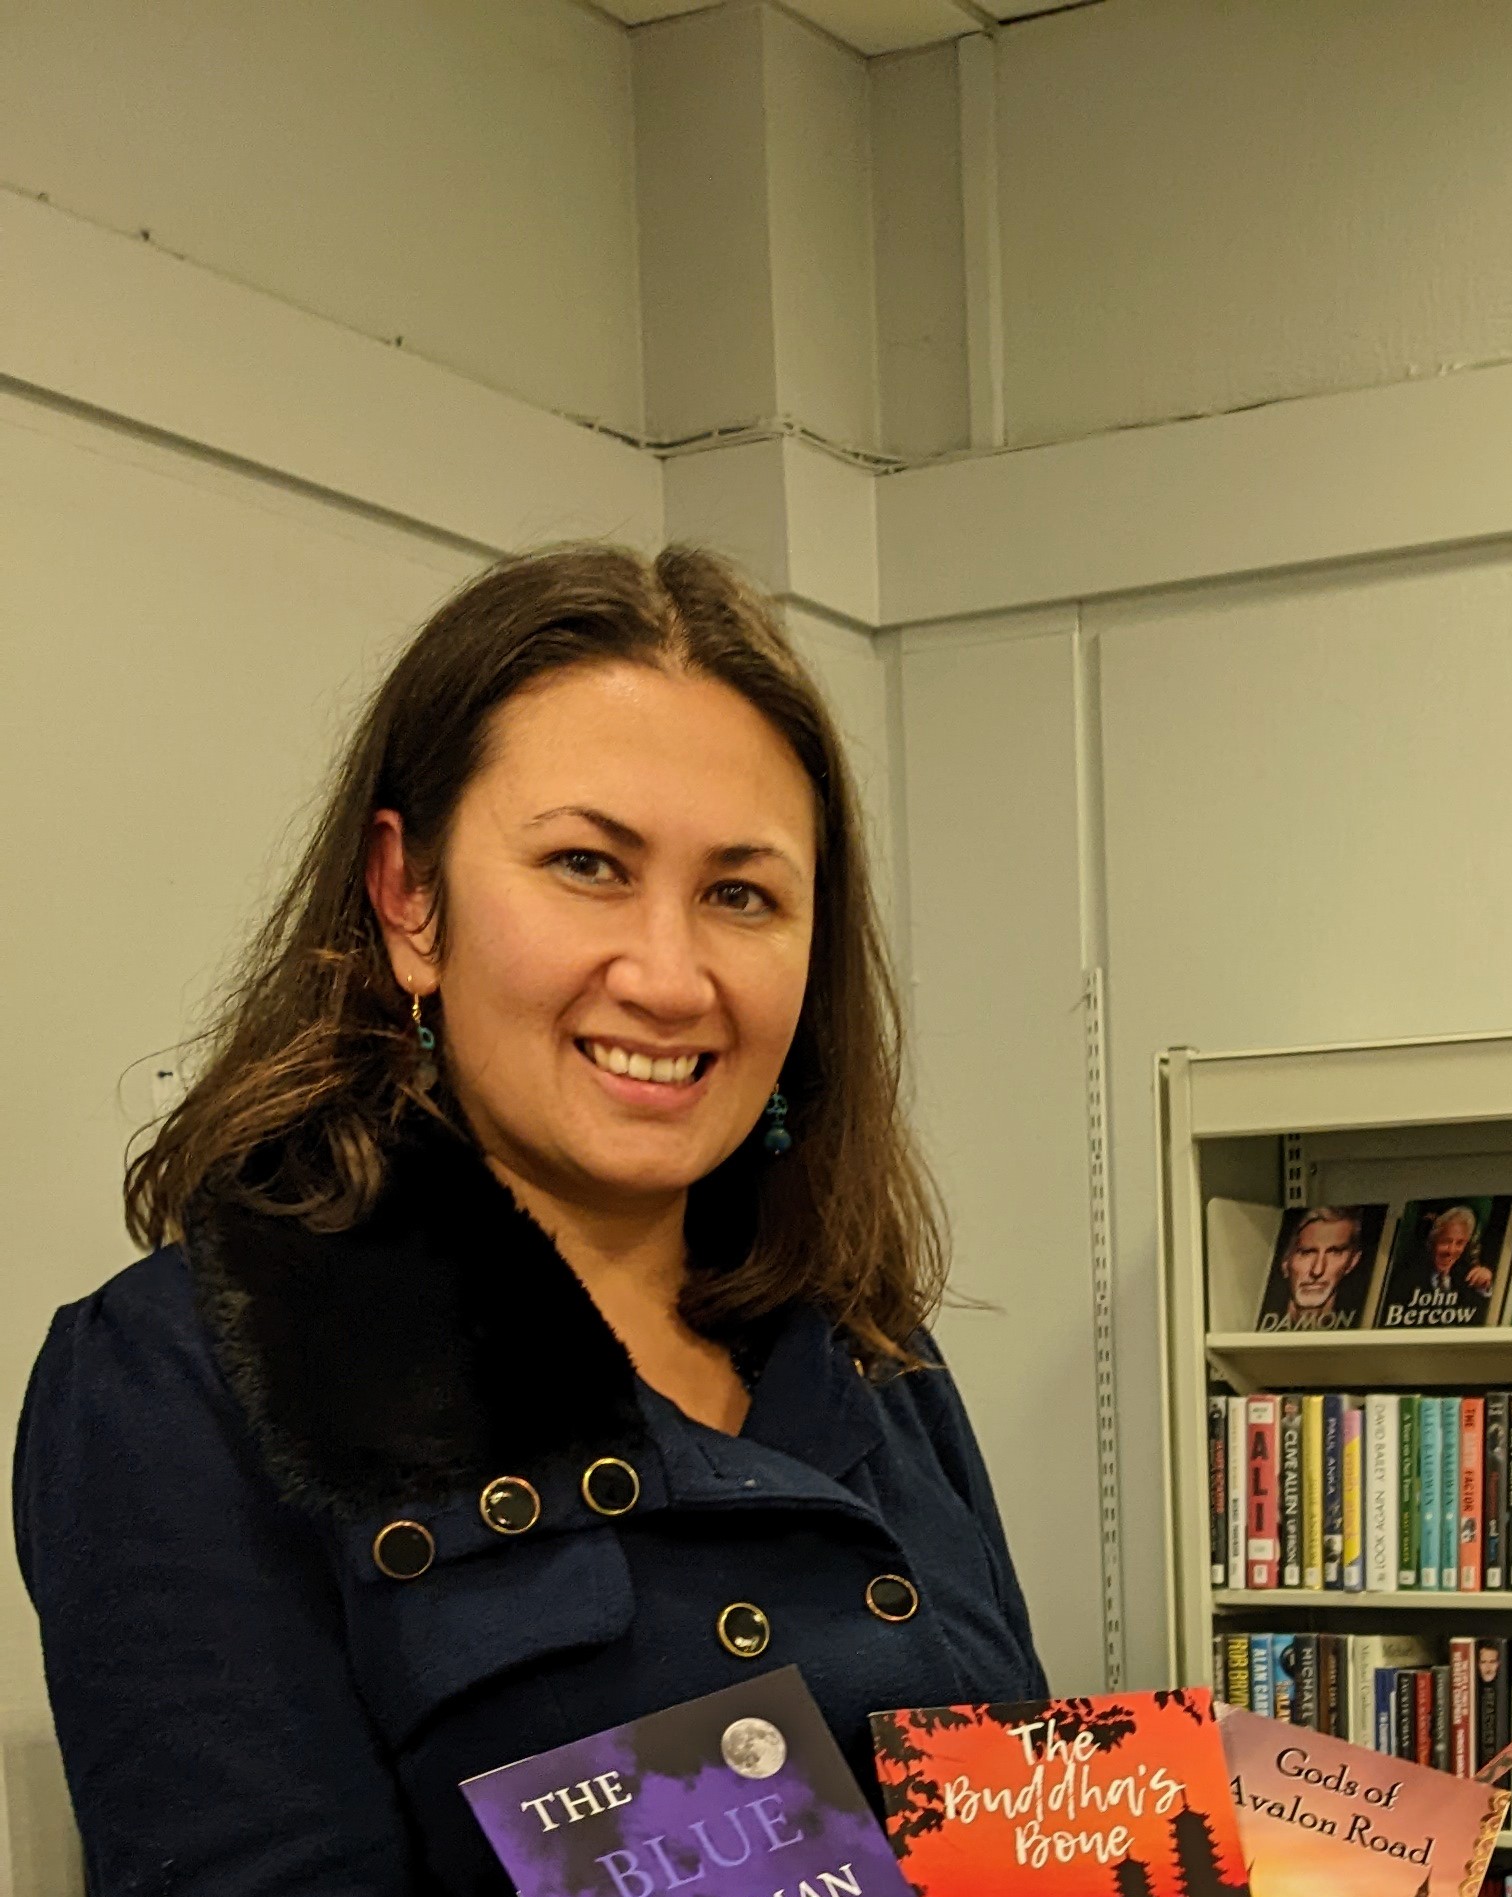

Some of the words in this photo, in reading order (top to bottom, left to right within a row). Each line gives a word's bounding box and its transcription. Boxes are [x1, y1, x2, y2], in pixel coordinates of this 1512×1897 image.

[1386, 1304, 1477, 1326] Bercow
[1408, 1286, 1457, 1307] John
[1260, 1310, 1356, 1332] DAMON
[1326, 1418, 1338, 1450] PAUL
[1374, 1405, 1386, 1440] DAVID
[1463, 1408, 1475, 1427] THE
[1285, 1430, 1298, 1470] CLIVE
[1374, 1443, 1387, 1481] BAILEY
[1252, 1431, 1268, 1532] ALI
[1285, 1471, 1298, 1514] ALLEN
[1326, 1457, 1338, 1495] ANKA
[1463, 1470, 1475, 1512] FACTOR
[1228, 1639, 1247, 1668] ROB
[1253, 1648, 1267, 1681] ALAN
[1301, 1648, 1313, 1720] MICHAEL
[1007, 1719, 1101, 1767] The
[943, 1763, 1186, 1825] Buddha's
[1275, 1747, 1359, 1796] Gods
[1363, 1780, 1400, 1810] of
[521, 1771, 632, 1833] THE
[1228, 1774, 1337, 1836] Avalon
[1344, 1813, 1436, 1866] Road
[1015, 1823, 1134, 1869] Bone
